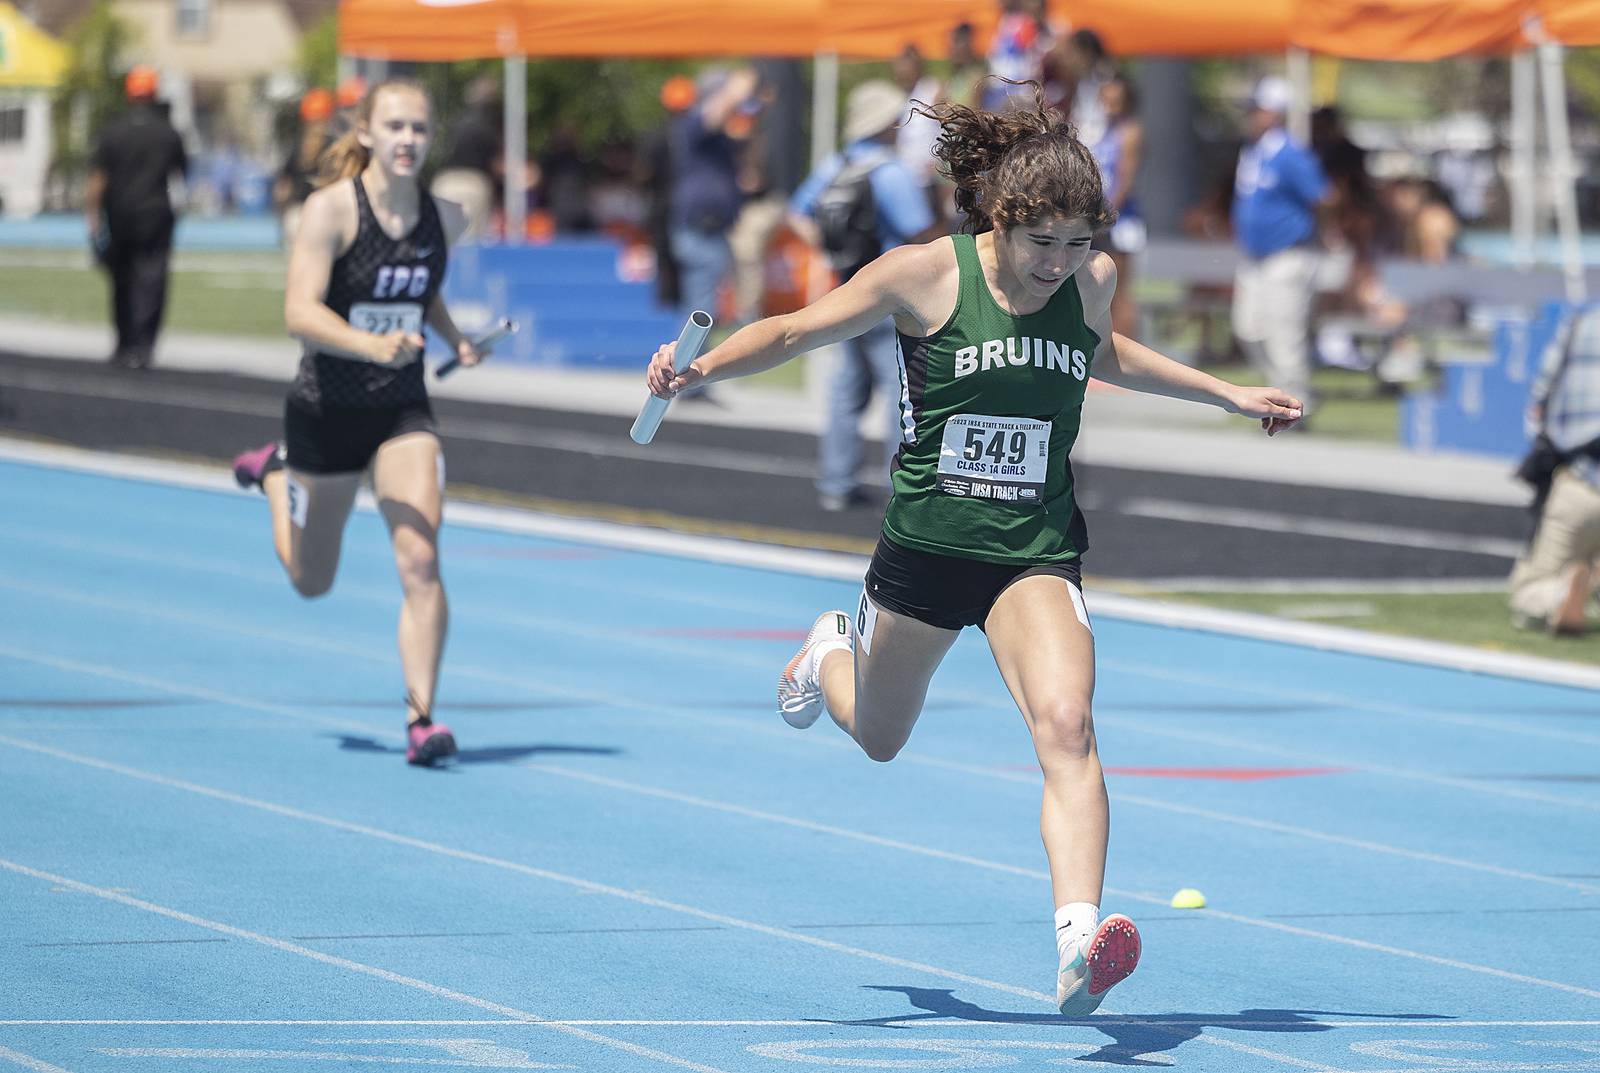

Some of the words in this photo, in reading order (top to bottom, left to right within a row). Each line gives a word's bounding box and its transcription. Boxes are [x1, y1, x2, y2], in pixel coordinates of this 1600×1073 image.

[954, 336, 1087, 382] BRUINS
[982, 421, 997, 429] STATE
[963, 427, 1027, 465] 549
[957, 460, 987, 473] CLASS
[990, 465, 999, 475] 1A
[1001, 464, 1026, 476] GIRLS
[971, 482, 991, 499] IHSA
[992, 485, 1019, 501] TRACK
